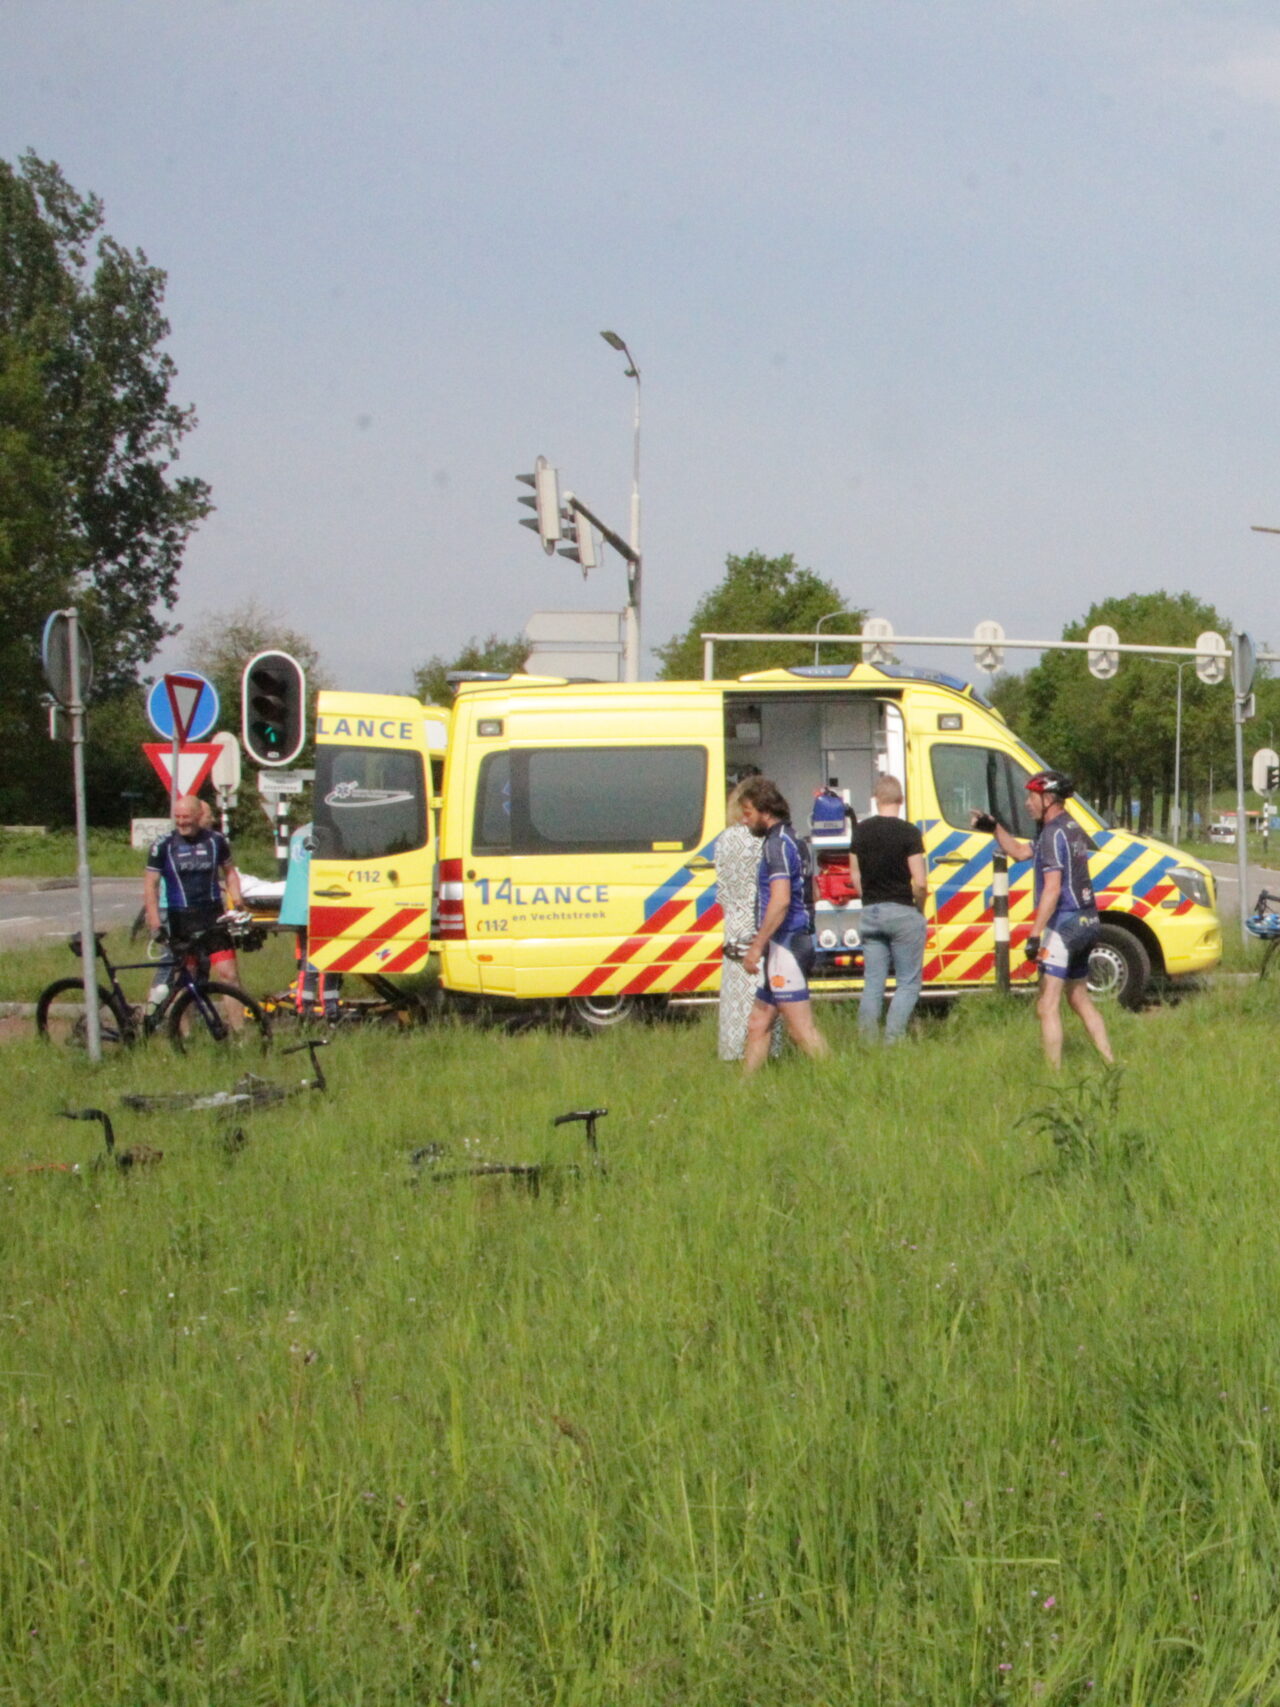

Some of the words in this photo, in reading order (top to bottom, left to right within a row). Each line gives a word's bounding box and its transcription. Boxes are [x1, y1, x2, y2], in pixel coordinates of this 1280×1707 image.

[317, 717, 413, 740] LANCE
[356, 871, 381, 882] 112
[515, 885, 609, 905] LANCE
[530, 911, 606, 920] Vechtstreek
[484, 919, 508, 931] 112
